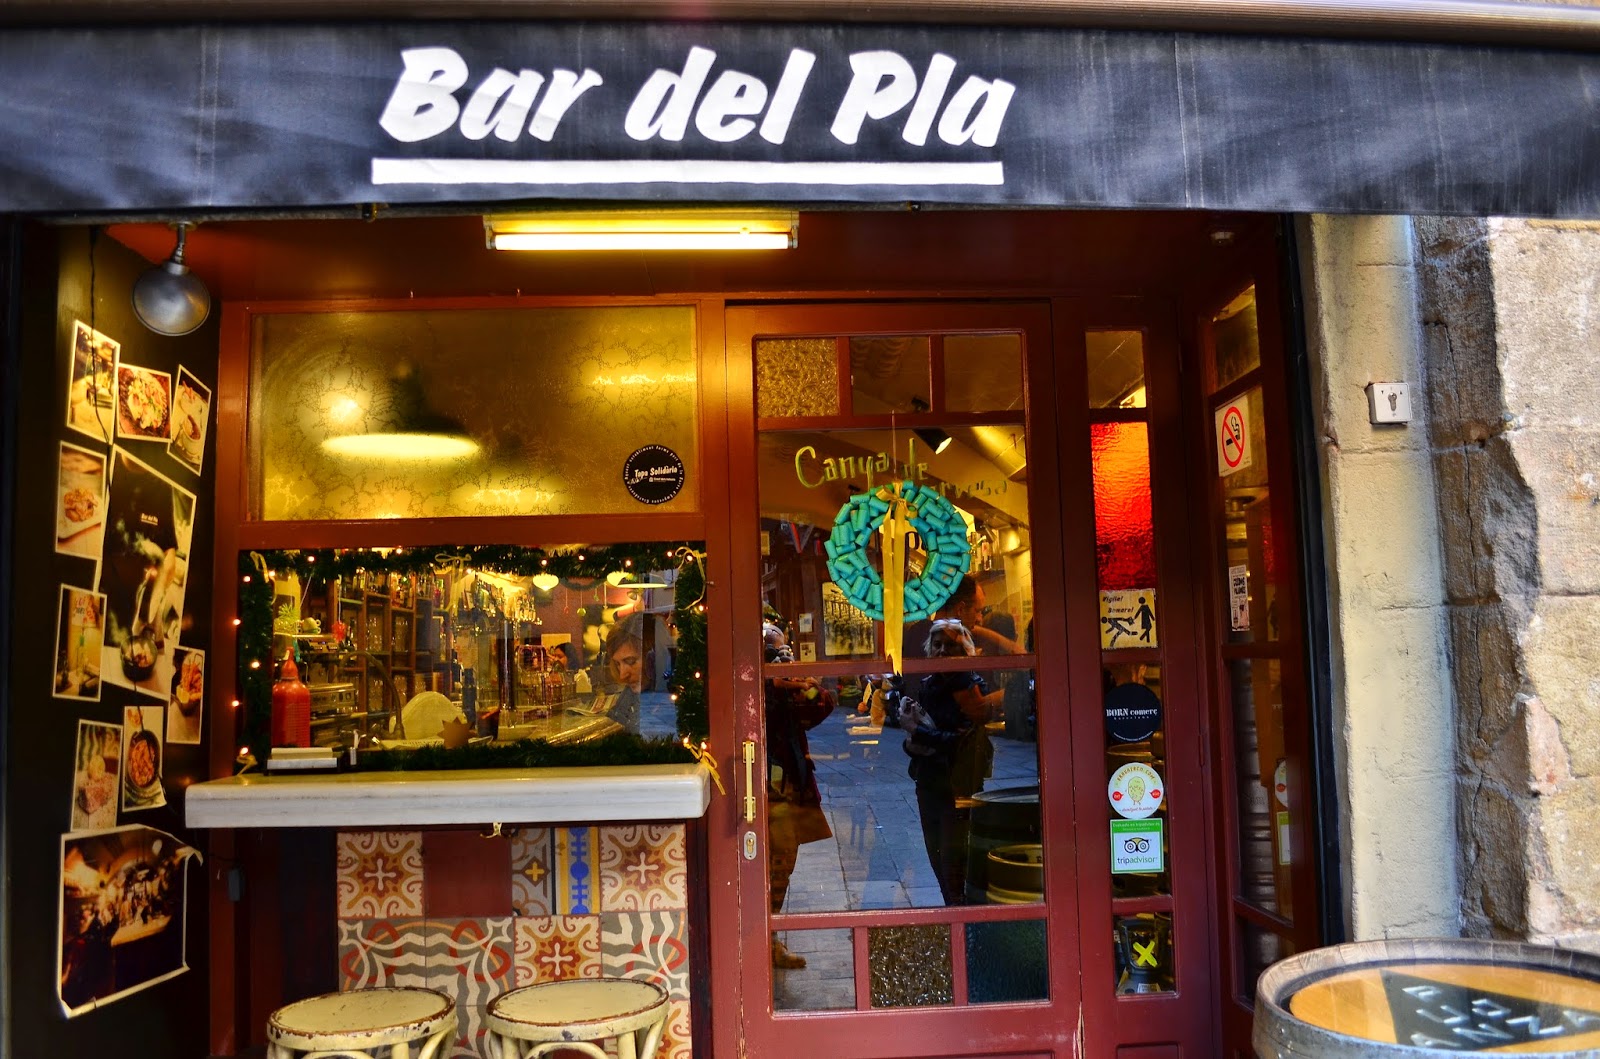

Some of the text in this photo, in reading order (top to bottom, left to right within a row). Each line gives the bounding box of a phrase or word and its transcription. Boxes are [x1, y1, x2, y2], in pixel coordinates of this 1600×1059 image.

[379, 46, 1016, 148] Bar del Pla
[794, 445, 891, 492] Canya
[1106, 708, 1129, 717] BORN
[1117, 856, 1156, 866] tripadvisor
